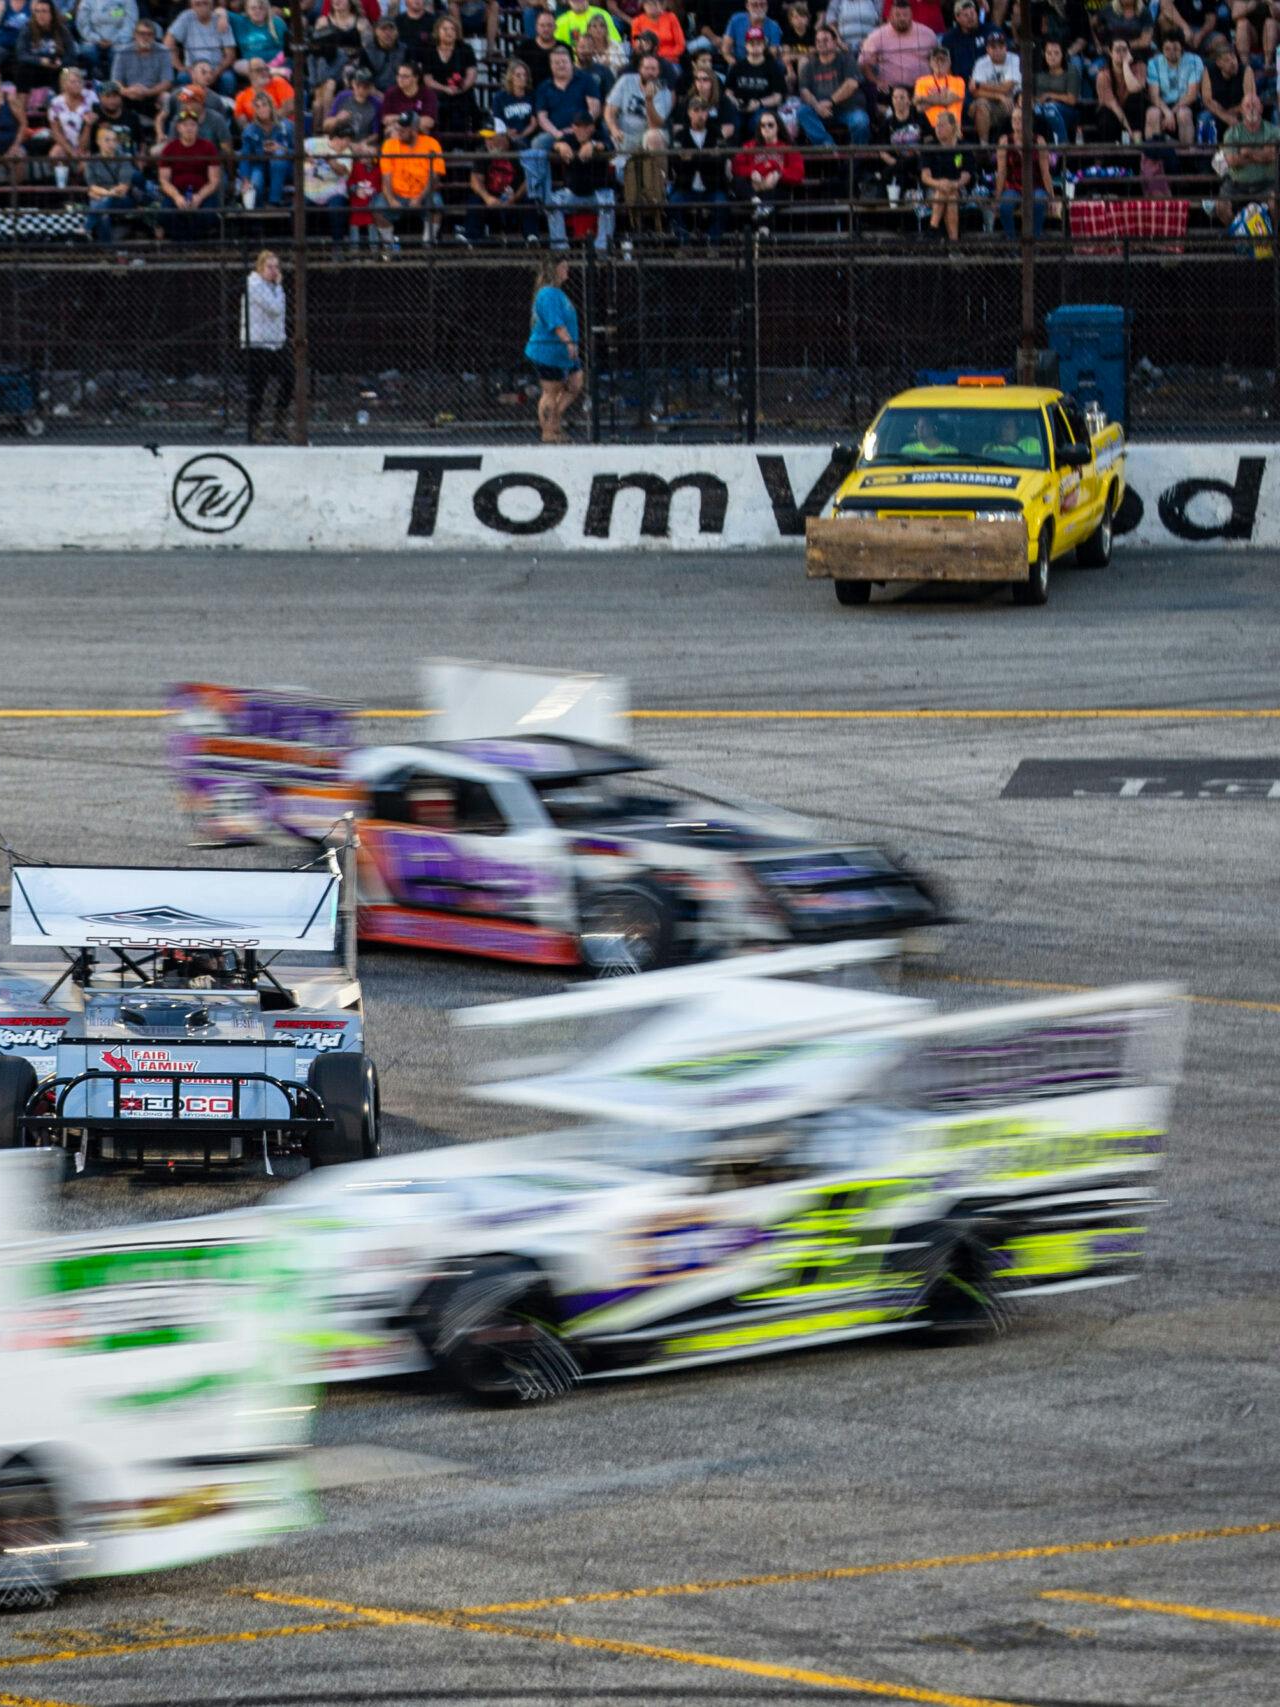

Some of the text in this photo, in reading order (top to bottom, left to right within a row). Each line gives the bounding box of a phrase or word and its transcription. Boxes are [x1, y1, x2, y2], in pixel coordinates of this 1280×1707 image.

[383, 455, 729, 538] Tom
[86, 936, 260, 949] TUNNY
[133, 1051, 167, 1060] FAIR
[140, 1061, 195, 1071] FAMILY
